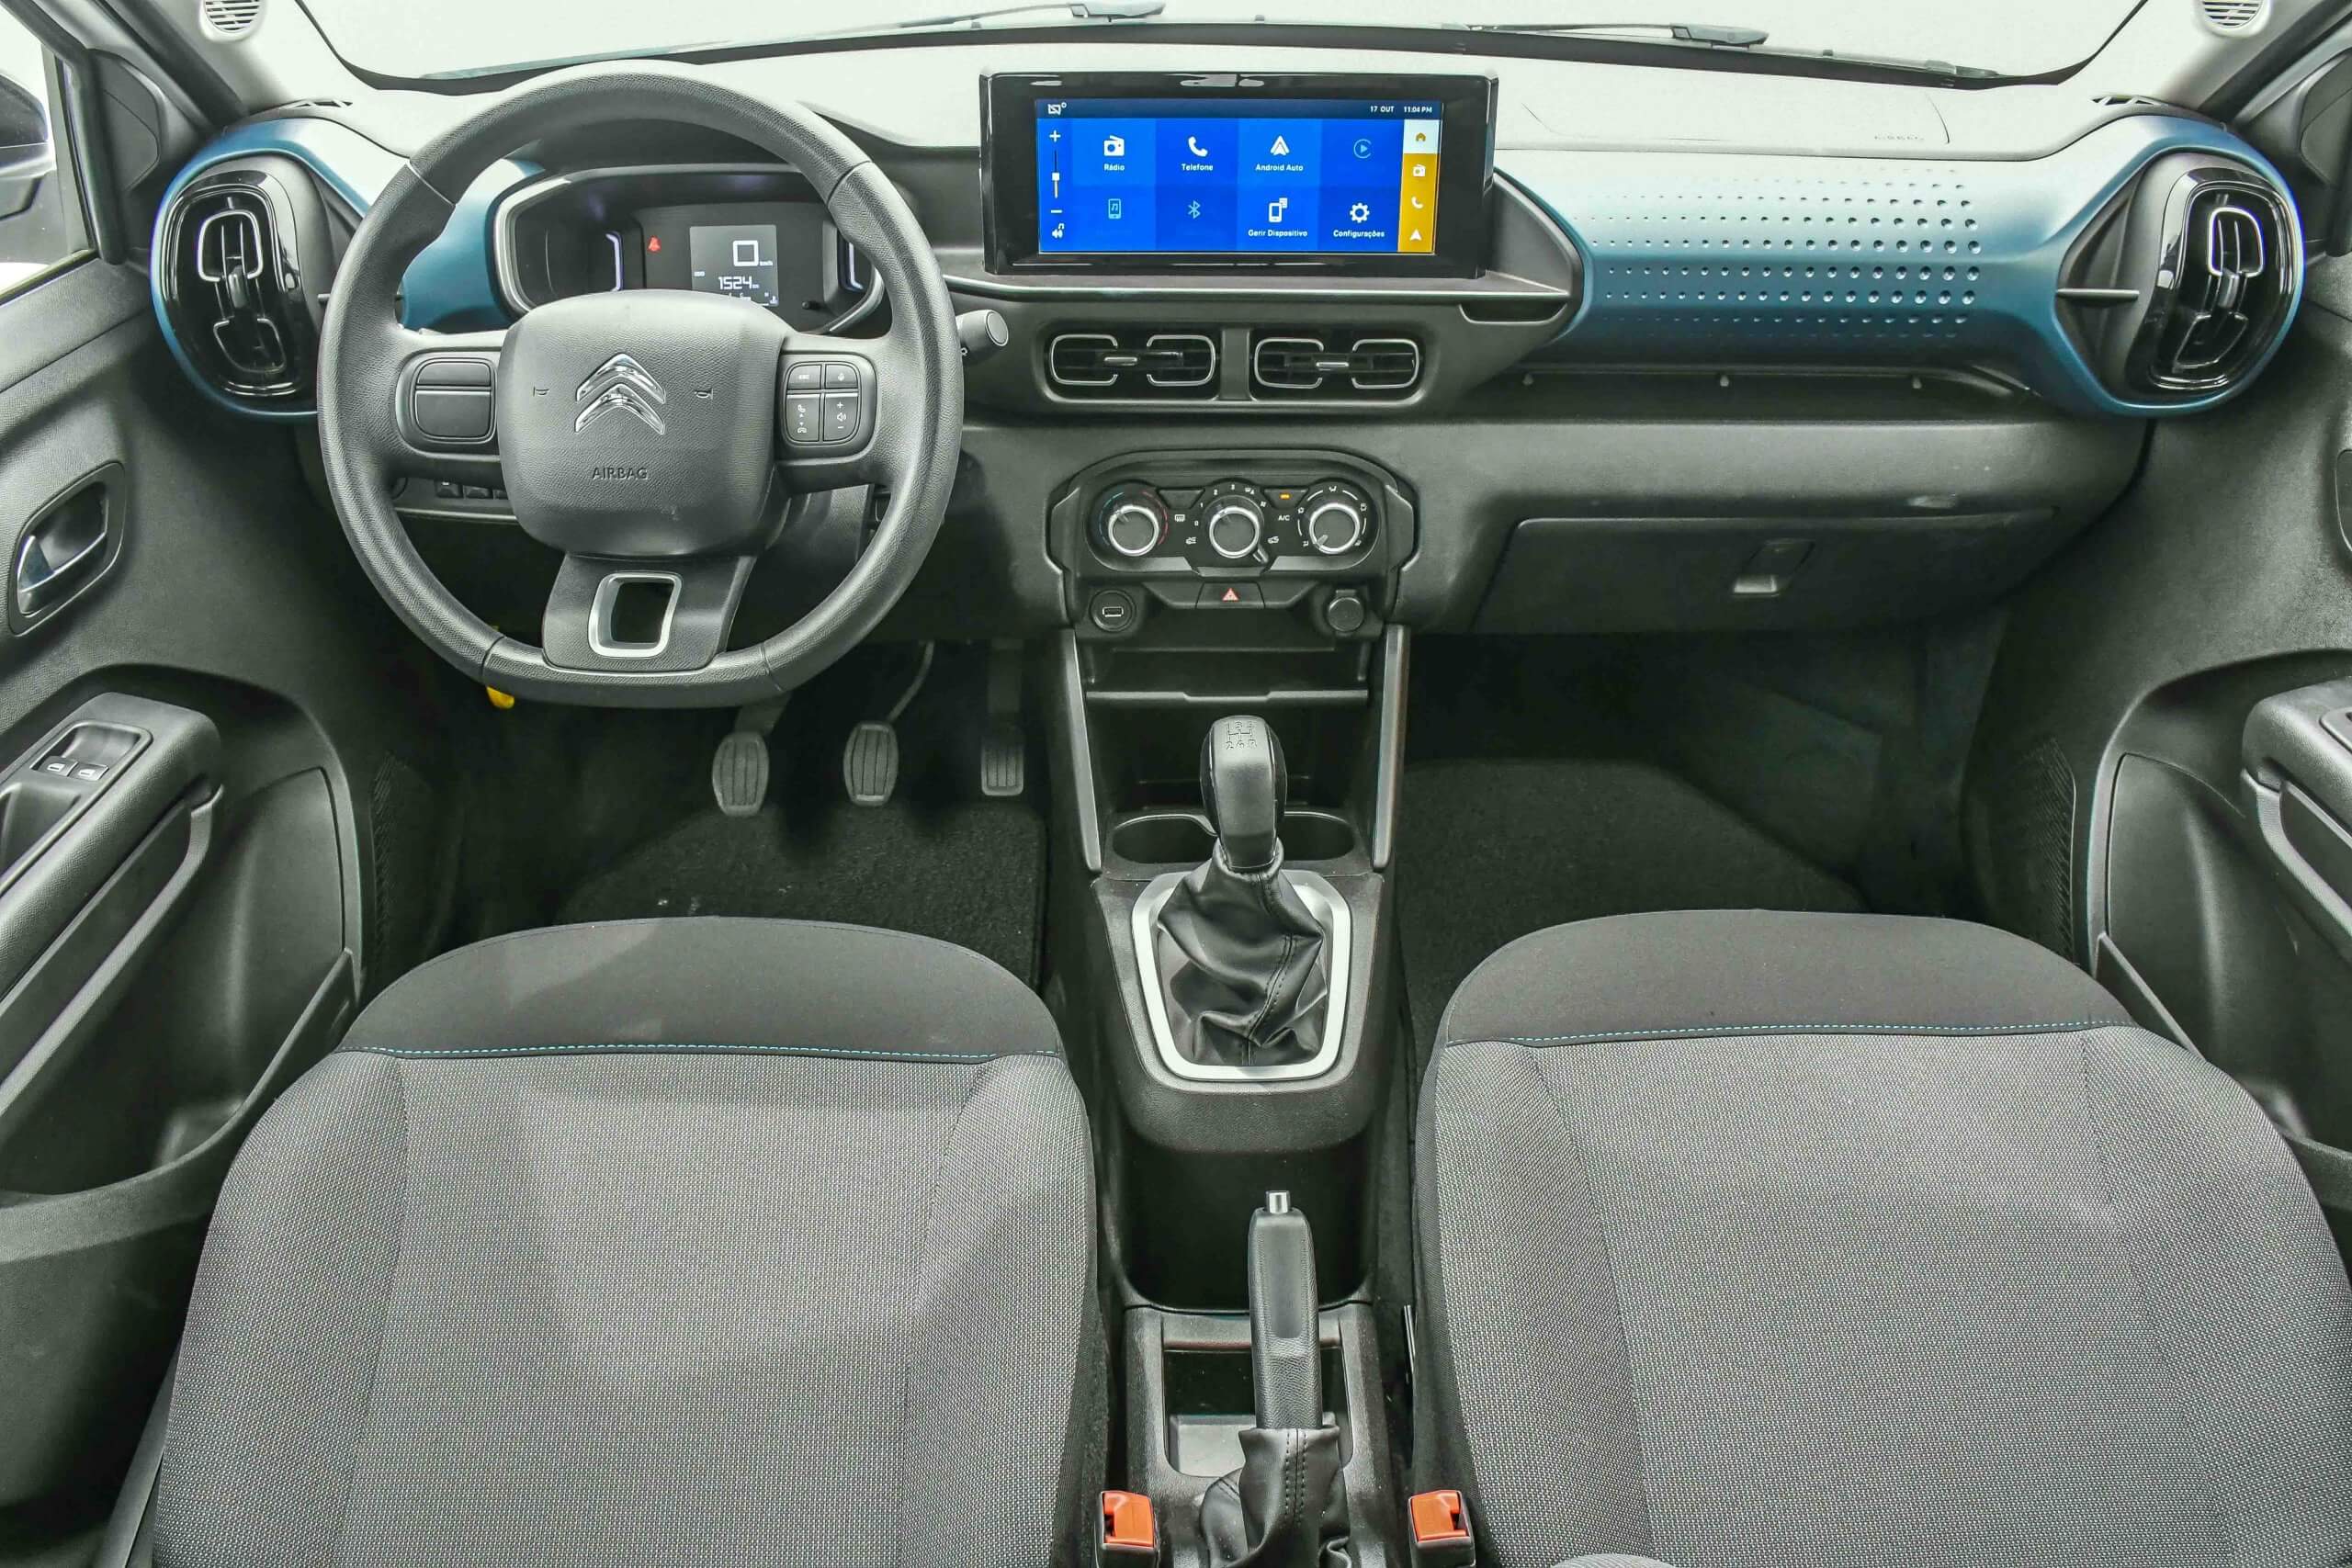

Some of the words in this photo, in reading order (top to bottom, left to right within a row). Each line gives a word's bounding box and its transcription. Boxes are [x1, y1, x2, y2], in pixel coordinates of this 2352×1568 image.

[1103, 163, 1125, 171] Rádio
[1181, 163, 1214, 172] Telefone
[1255, 163, 1284, 172] Android
[1286, 163, 1304, 172] Auto
[1248, 229, 1266, 237] Gerir
[1268, 229, 1308, 239] Dispositivo
[1333, 229, 1385, 239] Configurações
[718, 276, 752, 290] 1524
[592, 467, 649, 479] AIRBAG
